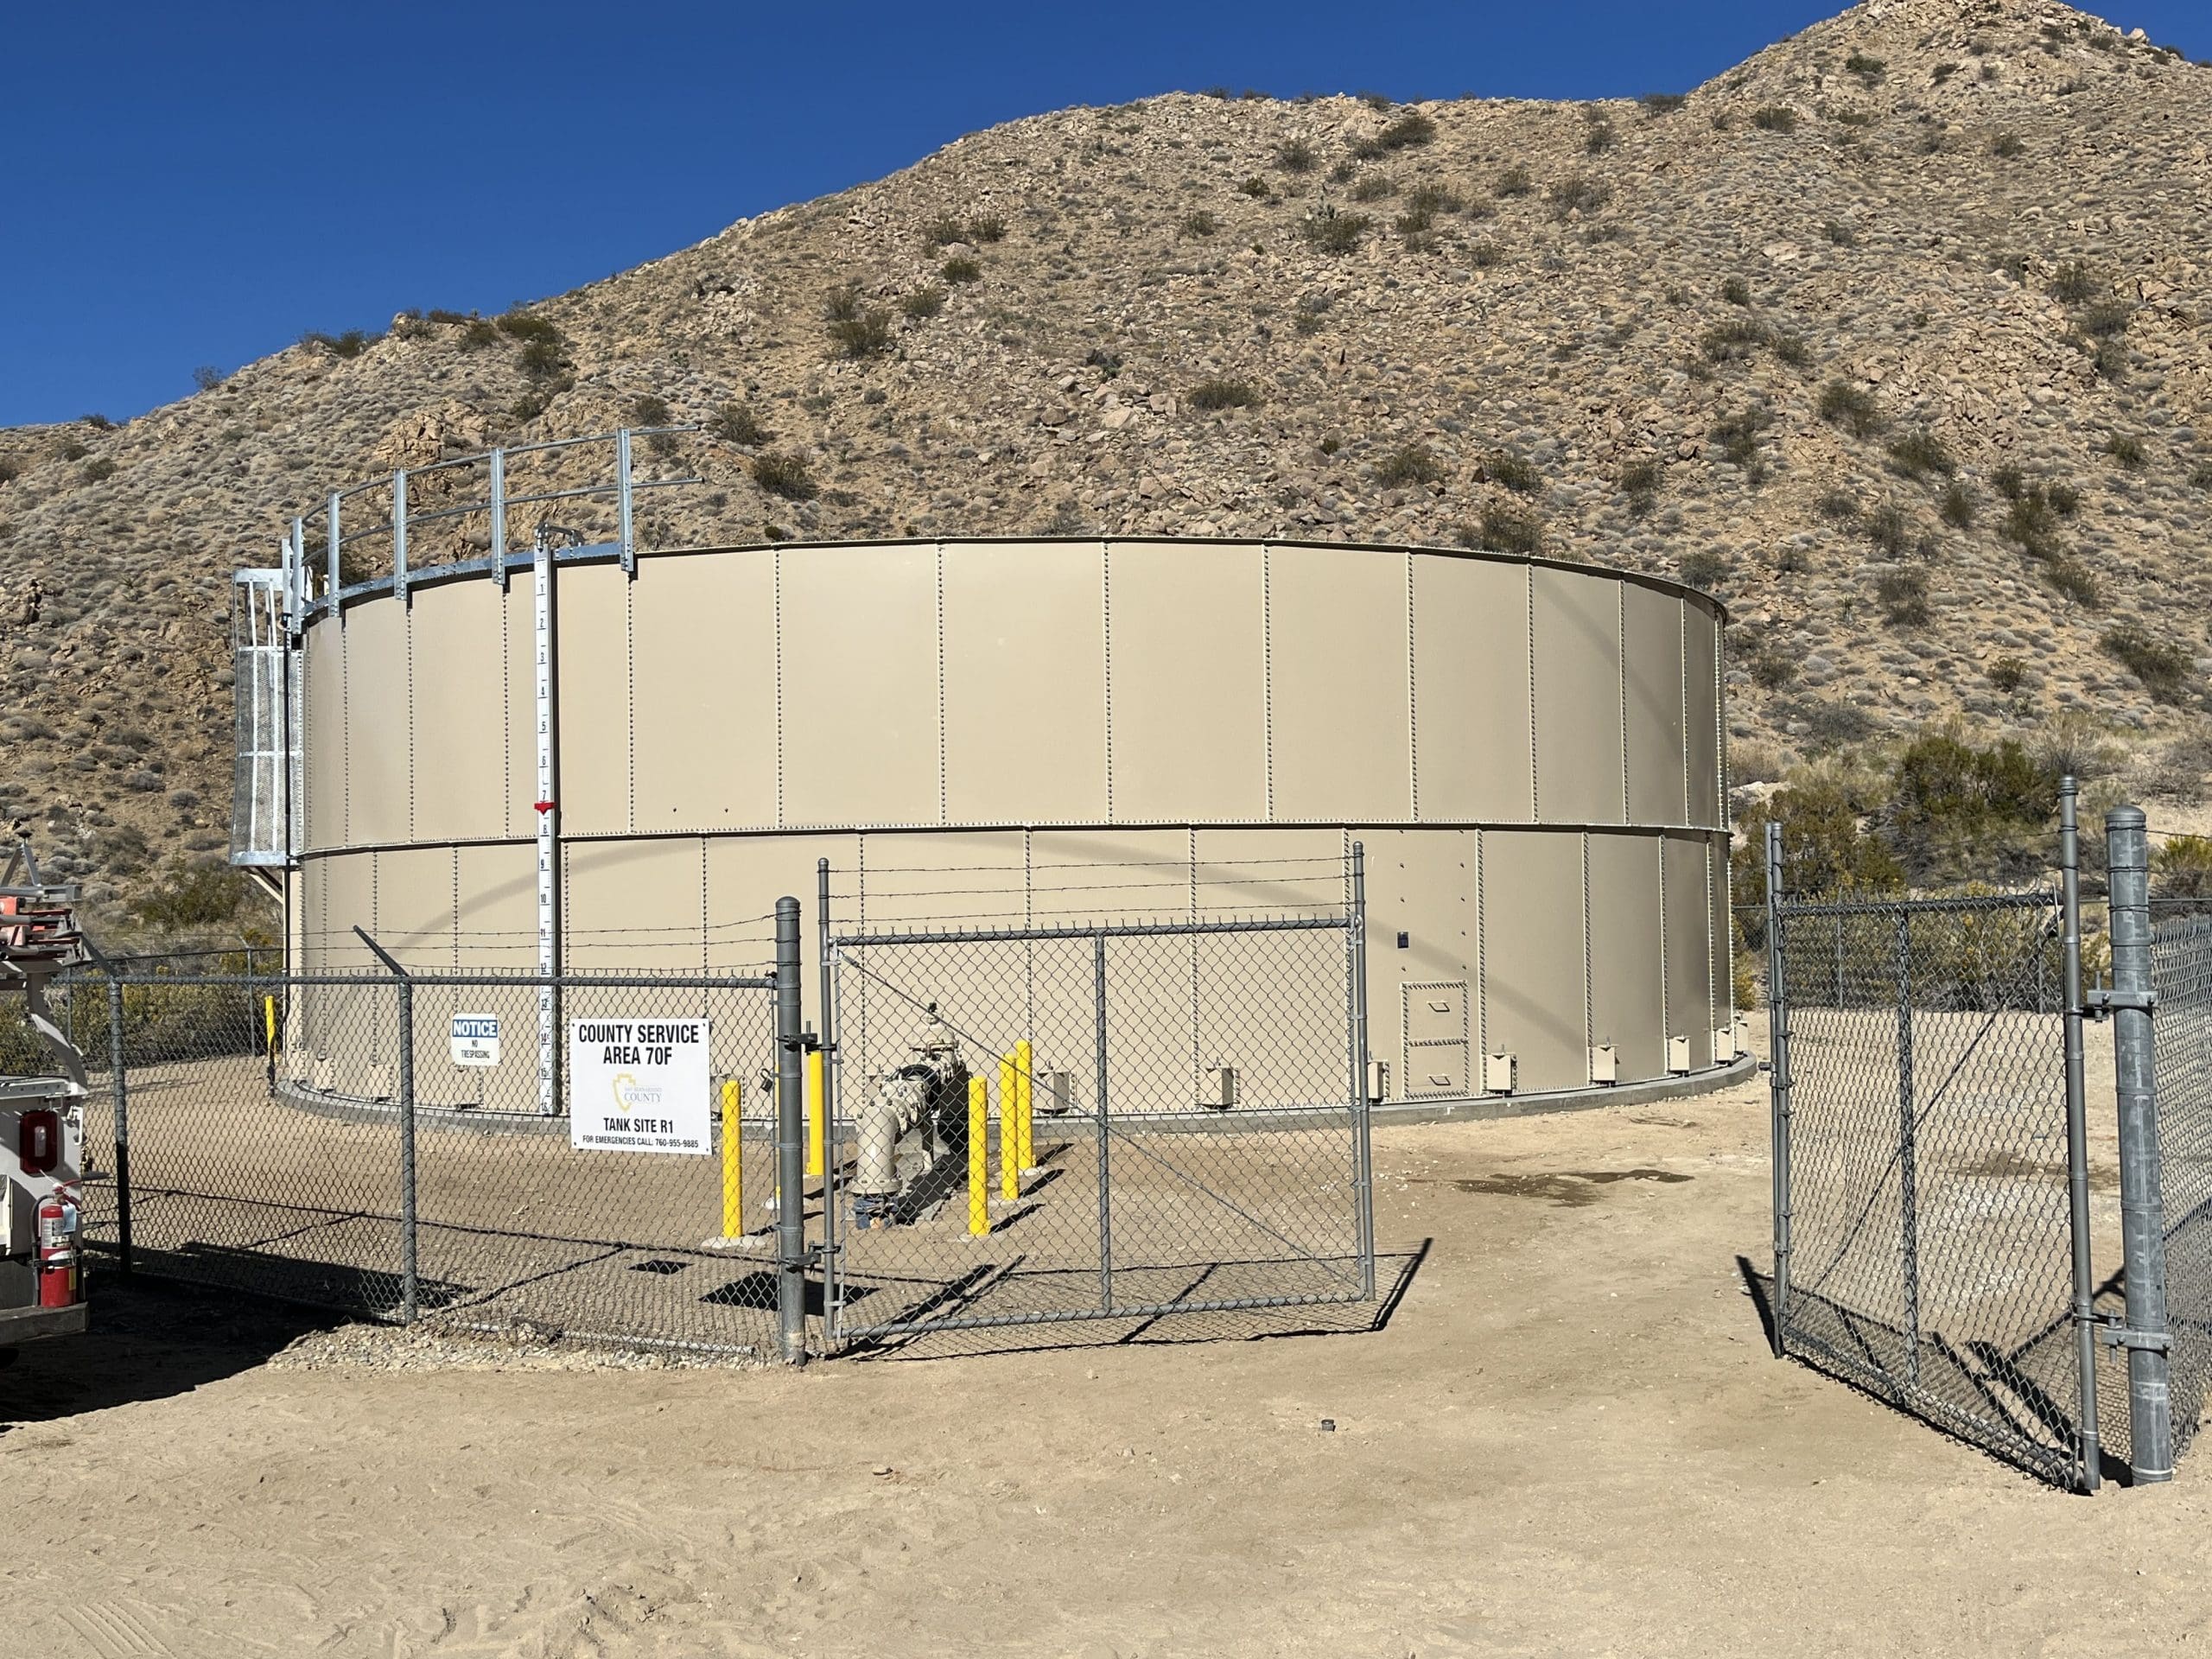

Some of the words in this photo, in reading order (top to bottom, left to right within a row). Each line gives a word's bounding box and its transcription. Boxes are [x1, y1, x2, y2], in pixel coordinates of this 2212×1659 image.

[540, 618, 544, 627] 2
[540, 652, 544, 662] 3
[541, 686, 544, 696] 4
[542, 721, 546, 731] 5
[542, 755, 546, 766] 6
[542, 790, 546, 800] 7
[543, 824, 547, 834] 8
[540, 859, 544, 868] 9
[540, 893, 546, 903] 10
[540, 928, 545, 937] 11
[454, 1021, 497, 1036] NOTICE
[579, 1024, 632, 1043] COUNTY
[638, 1025, 699, 1044] SERVICE
[603, 1046, 641, 1065] AREA
[646, 1046, 672, 1065] 70F
[541, 1068, 547, 1077] 15
[624, 1092, 662, 1103] COUNTY
[603, 1117, 631, 1132] TANK
[634, 1119, 658, 1133] SITE
[661, 1120, 674, 1134] R1
[594, 1135, 635, 1146] EMERGENCIES
[637, 1137, 653, 1146] CALL:
[655, 1138, 699, 1148] 760-955-9885
